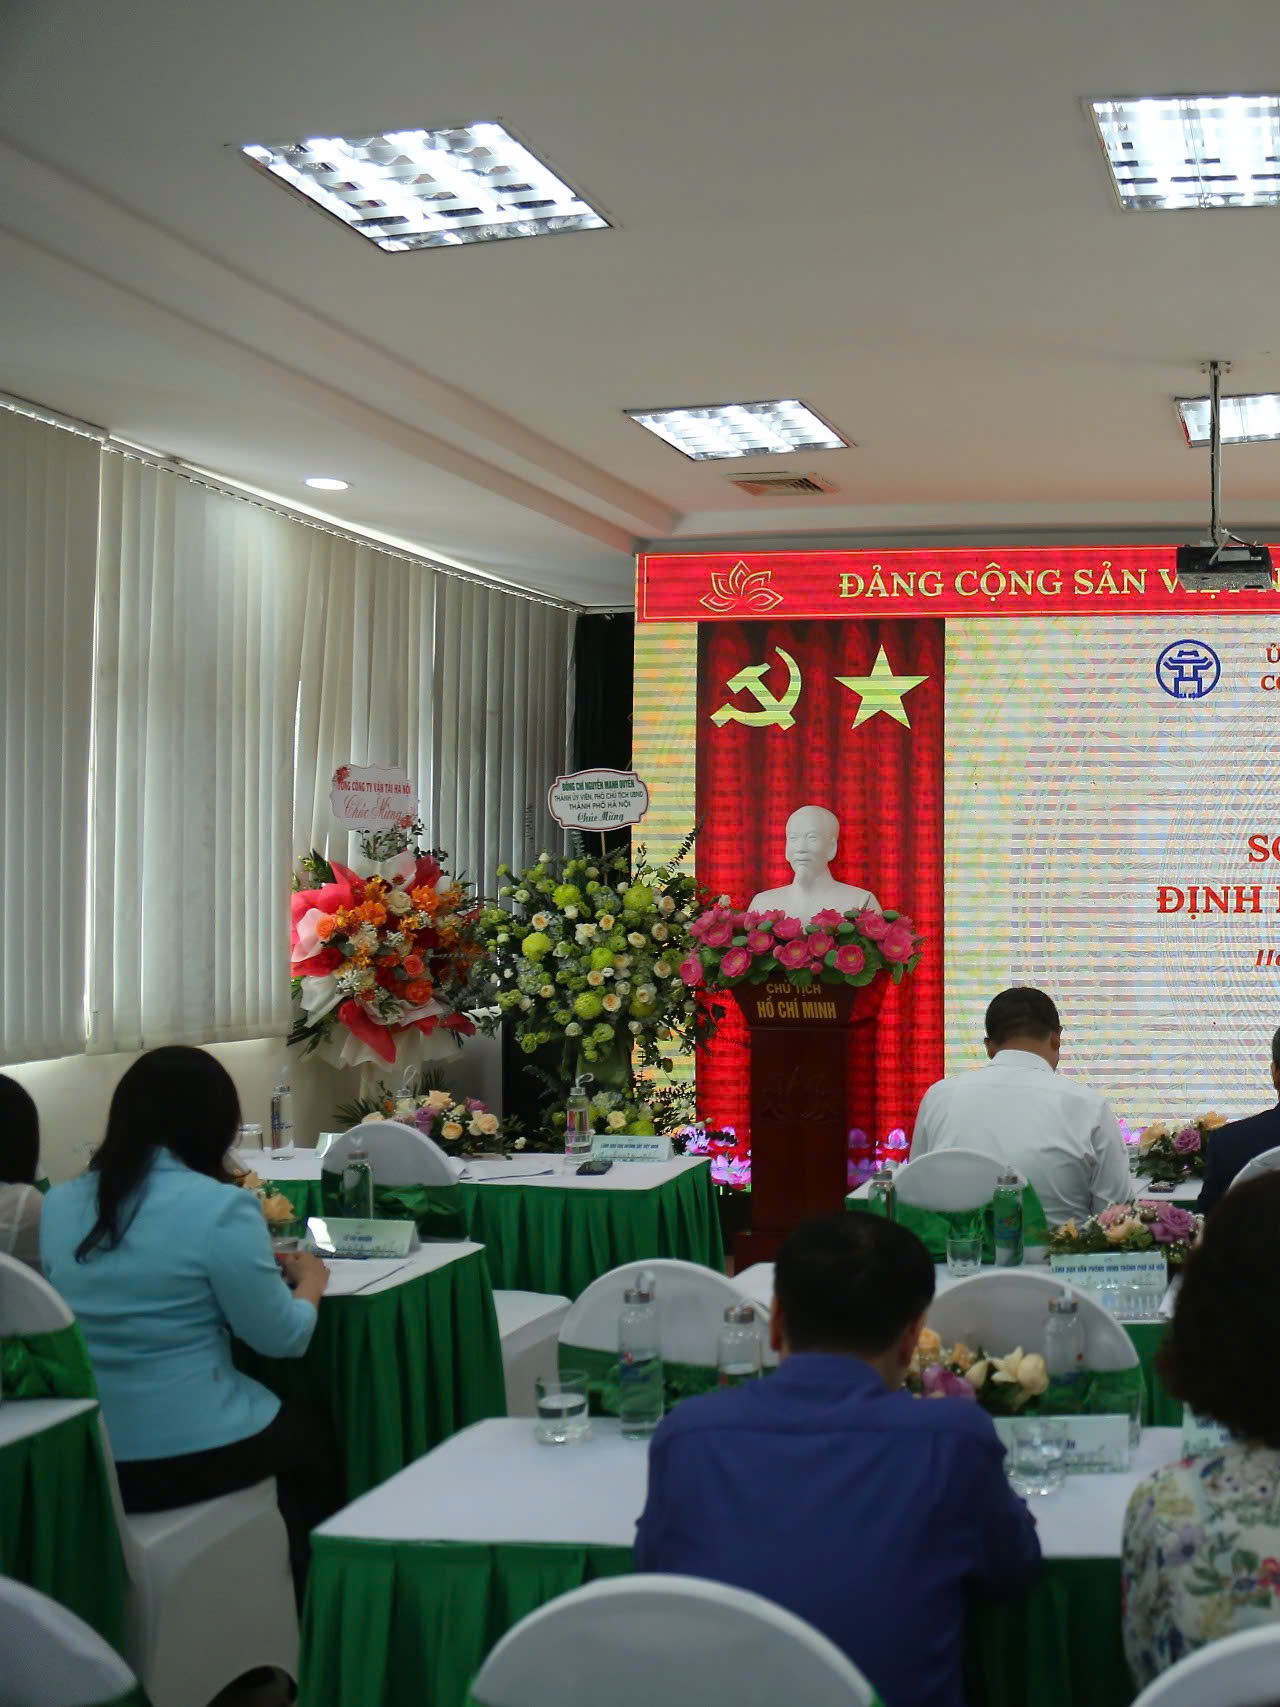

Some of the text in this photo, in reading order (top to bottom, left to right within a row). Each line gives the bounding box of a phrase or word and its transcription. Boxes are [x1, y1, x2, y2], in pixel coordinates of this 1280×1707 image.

[838, 563, 945, 599] ĐẢNG
[954, 562, 1063, 603] CỘNG
[1073, 560, 1148, 595] SẢN
[569, 801, 591, 811] THÀNH
[618, 799, 631, 809] NỘI
[577, 811, 598, 823] Chúc
[1156, 884, 1263, 922] ĐỊNH
[757, 995, 838, 1019] HỒ CHÍ MINH
